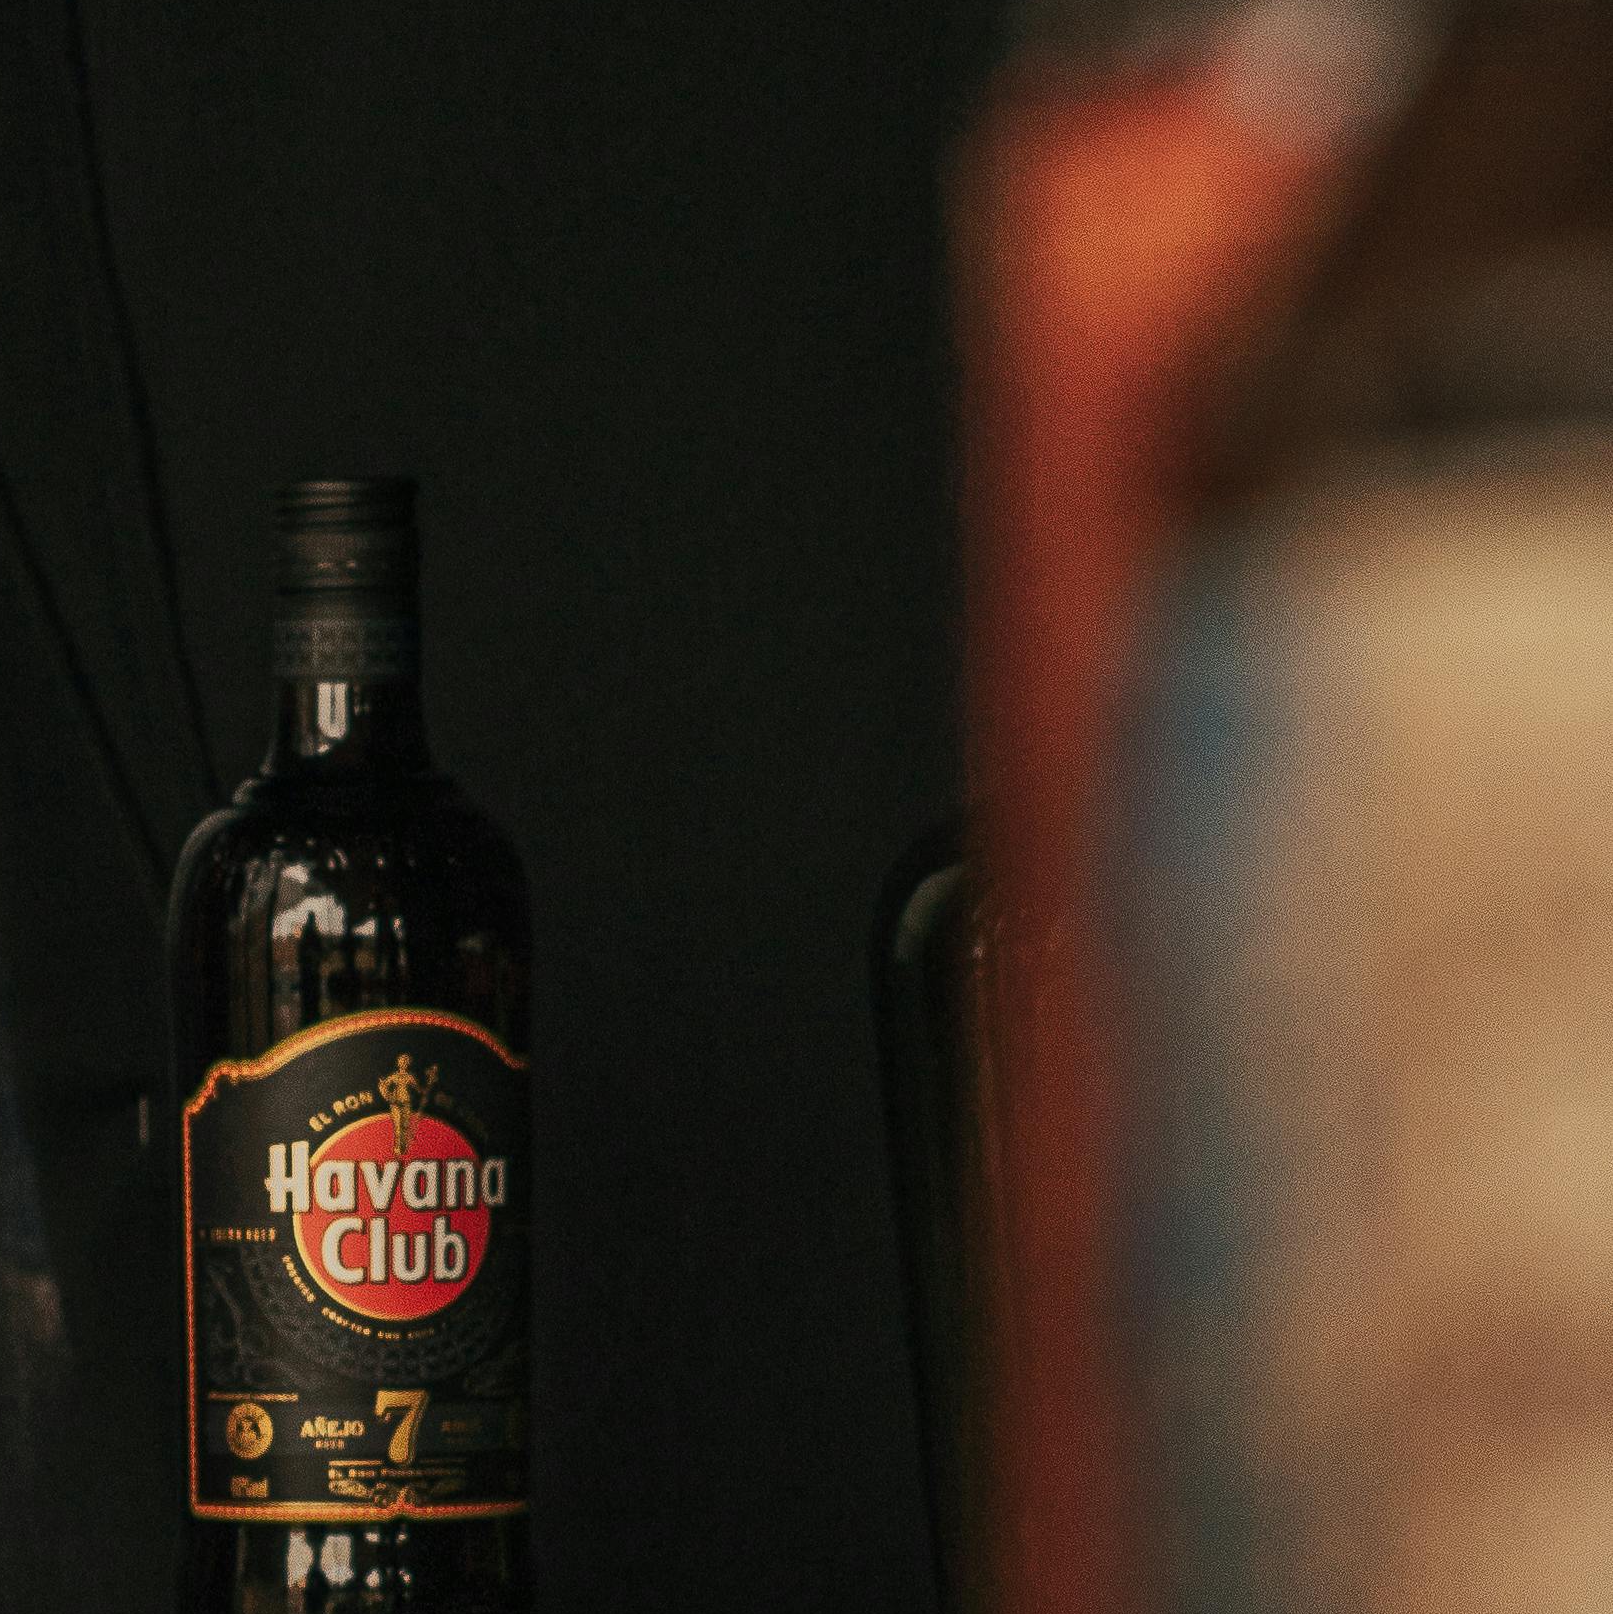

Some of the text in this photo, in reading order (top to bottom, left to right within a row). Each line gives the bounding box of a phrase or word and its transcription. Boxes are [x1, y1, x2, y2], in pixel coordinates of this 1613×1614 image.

[308, 1090, 375, 1133] EL RON
[263, 1139, 508, 1214] Havana
[320, 1215, 470, 1285] Club
[300, 1388, 430, 1465] AÑEJO 7
